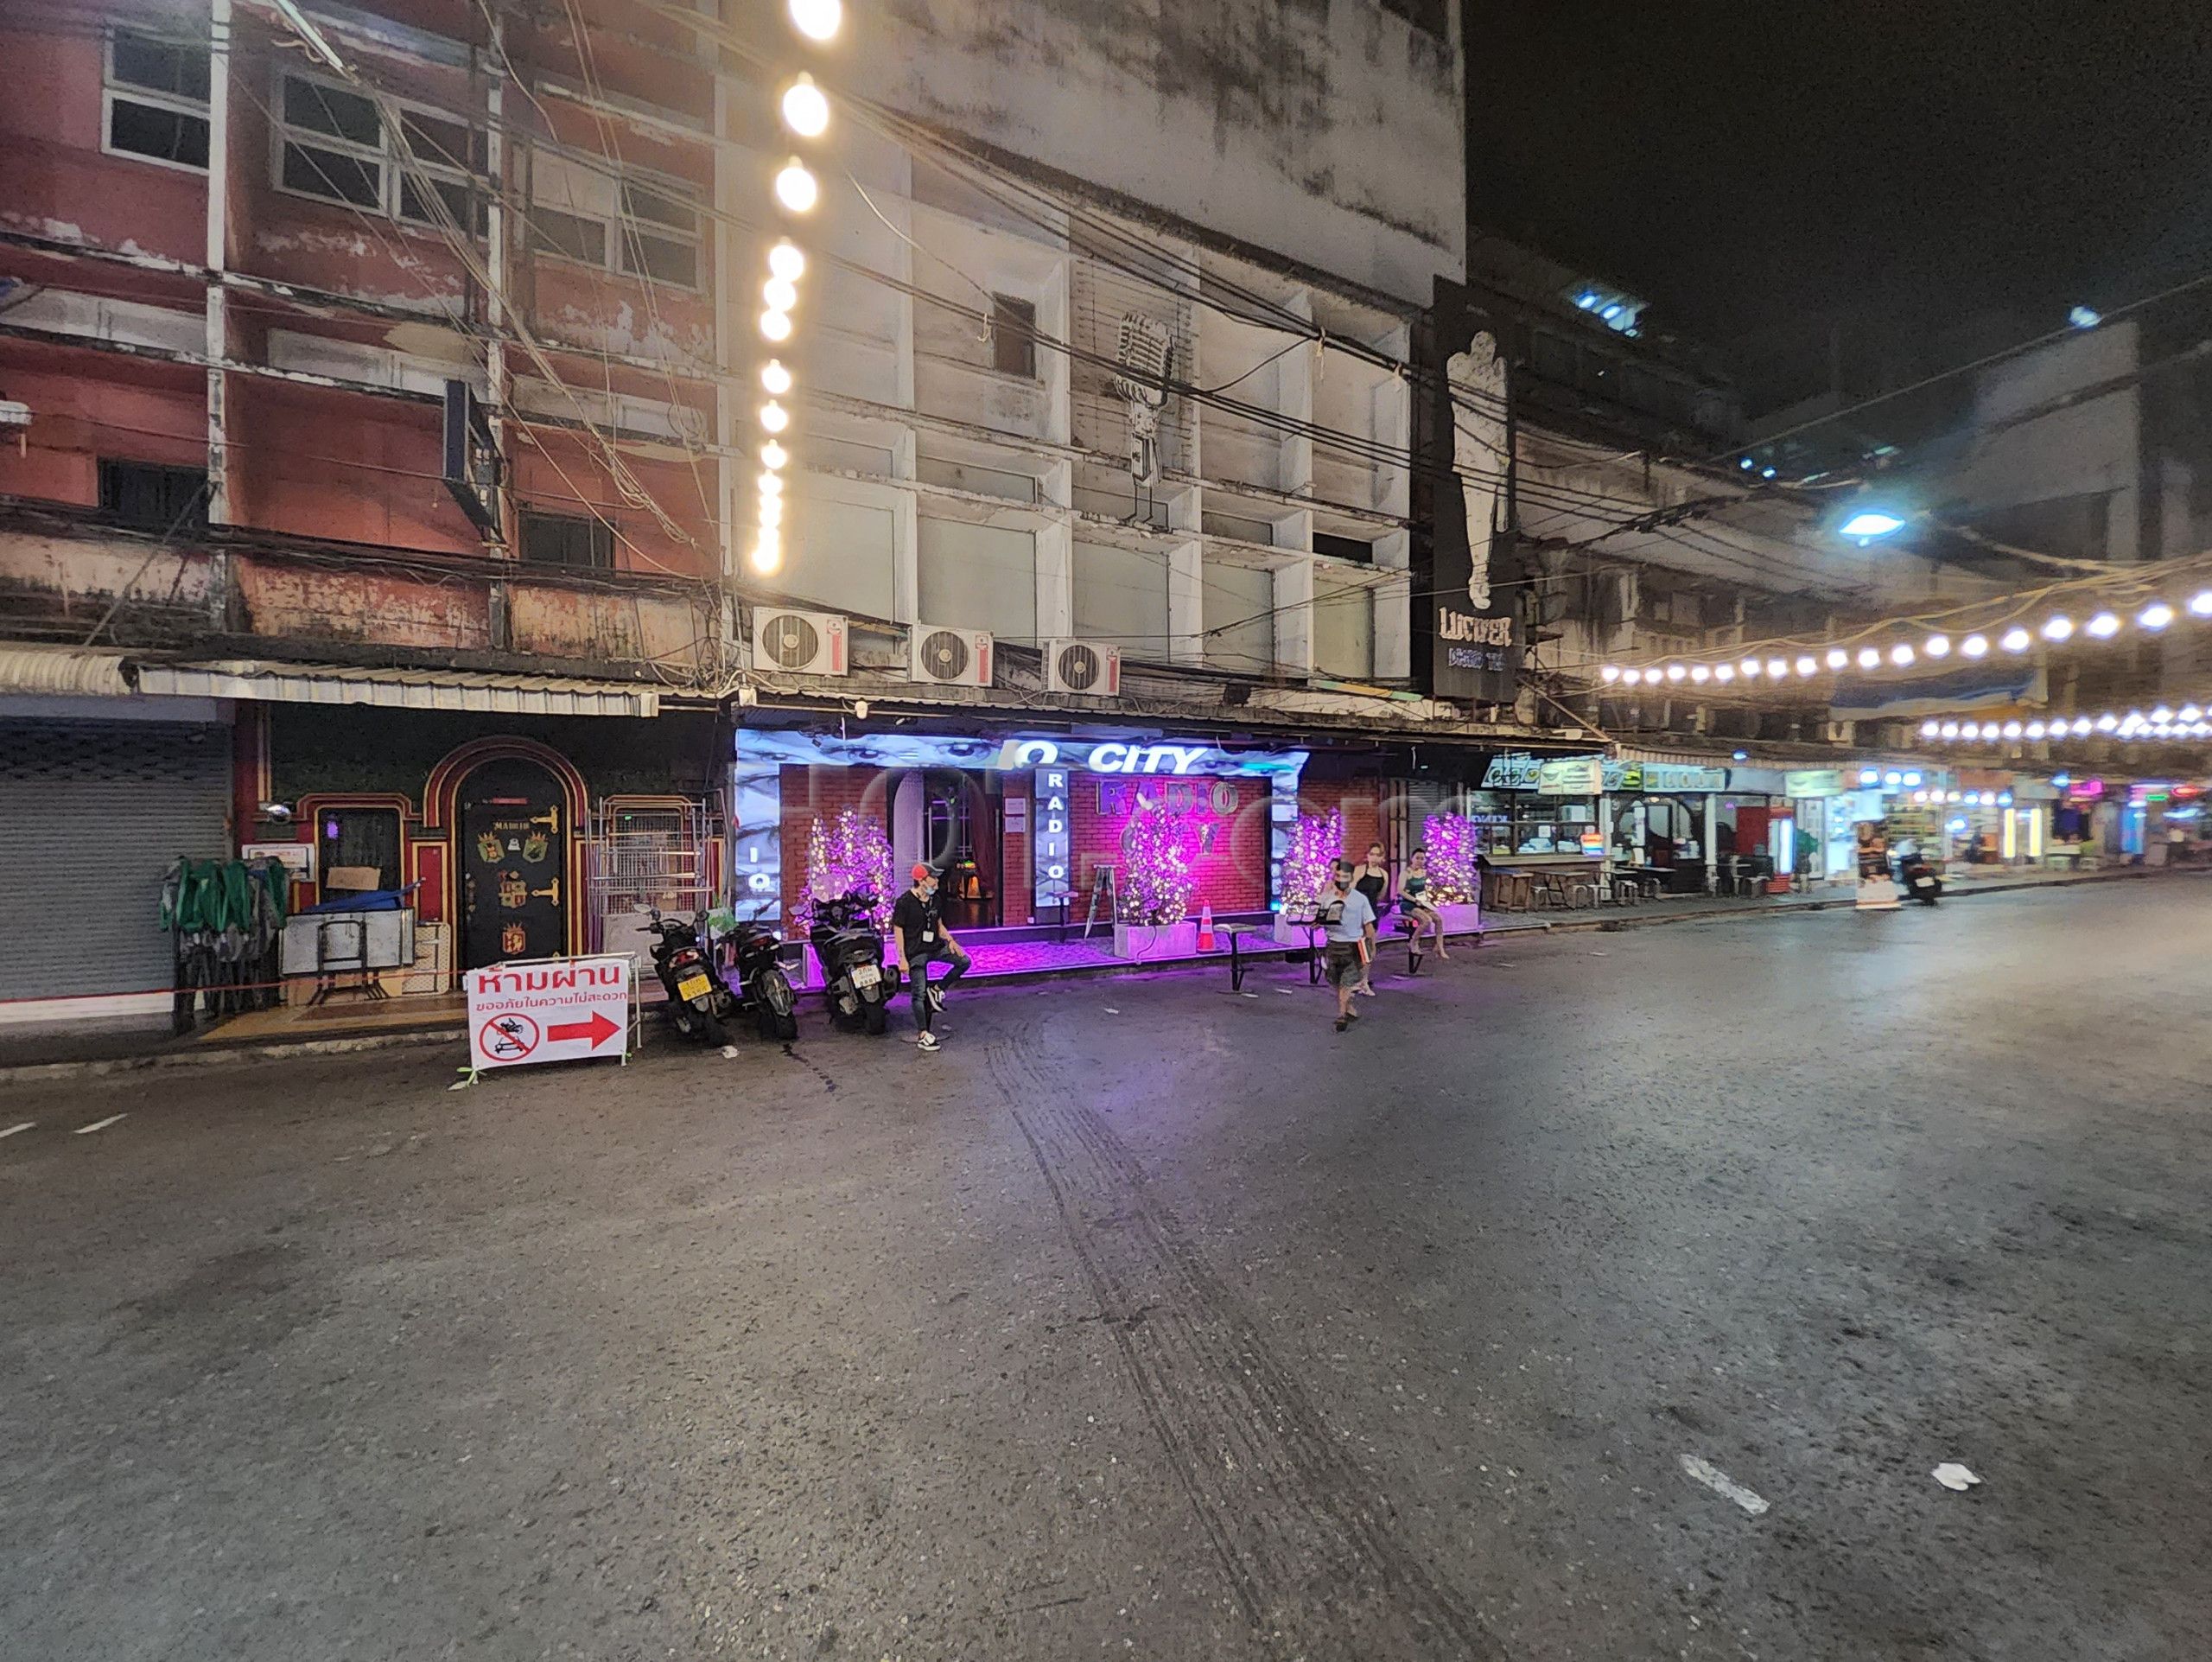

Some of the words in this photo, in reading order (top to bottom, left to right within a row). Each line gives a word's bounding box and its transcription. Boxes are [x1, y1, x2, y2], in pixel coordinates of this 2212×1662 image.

[1439, 607, 1512, 646] LUCIFER
[1089, 742, 1208, 774] CITY
[1096, 780, 1239, 815] RADIO
[1047, 773, 1065, 879] RADIO
[478, 959, 620, 994] ห้ามผ่าน
[476, 991, 627, 1012] ขออภัยในความไม่สะดวก
